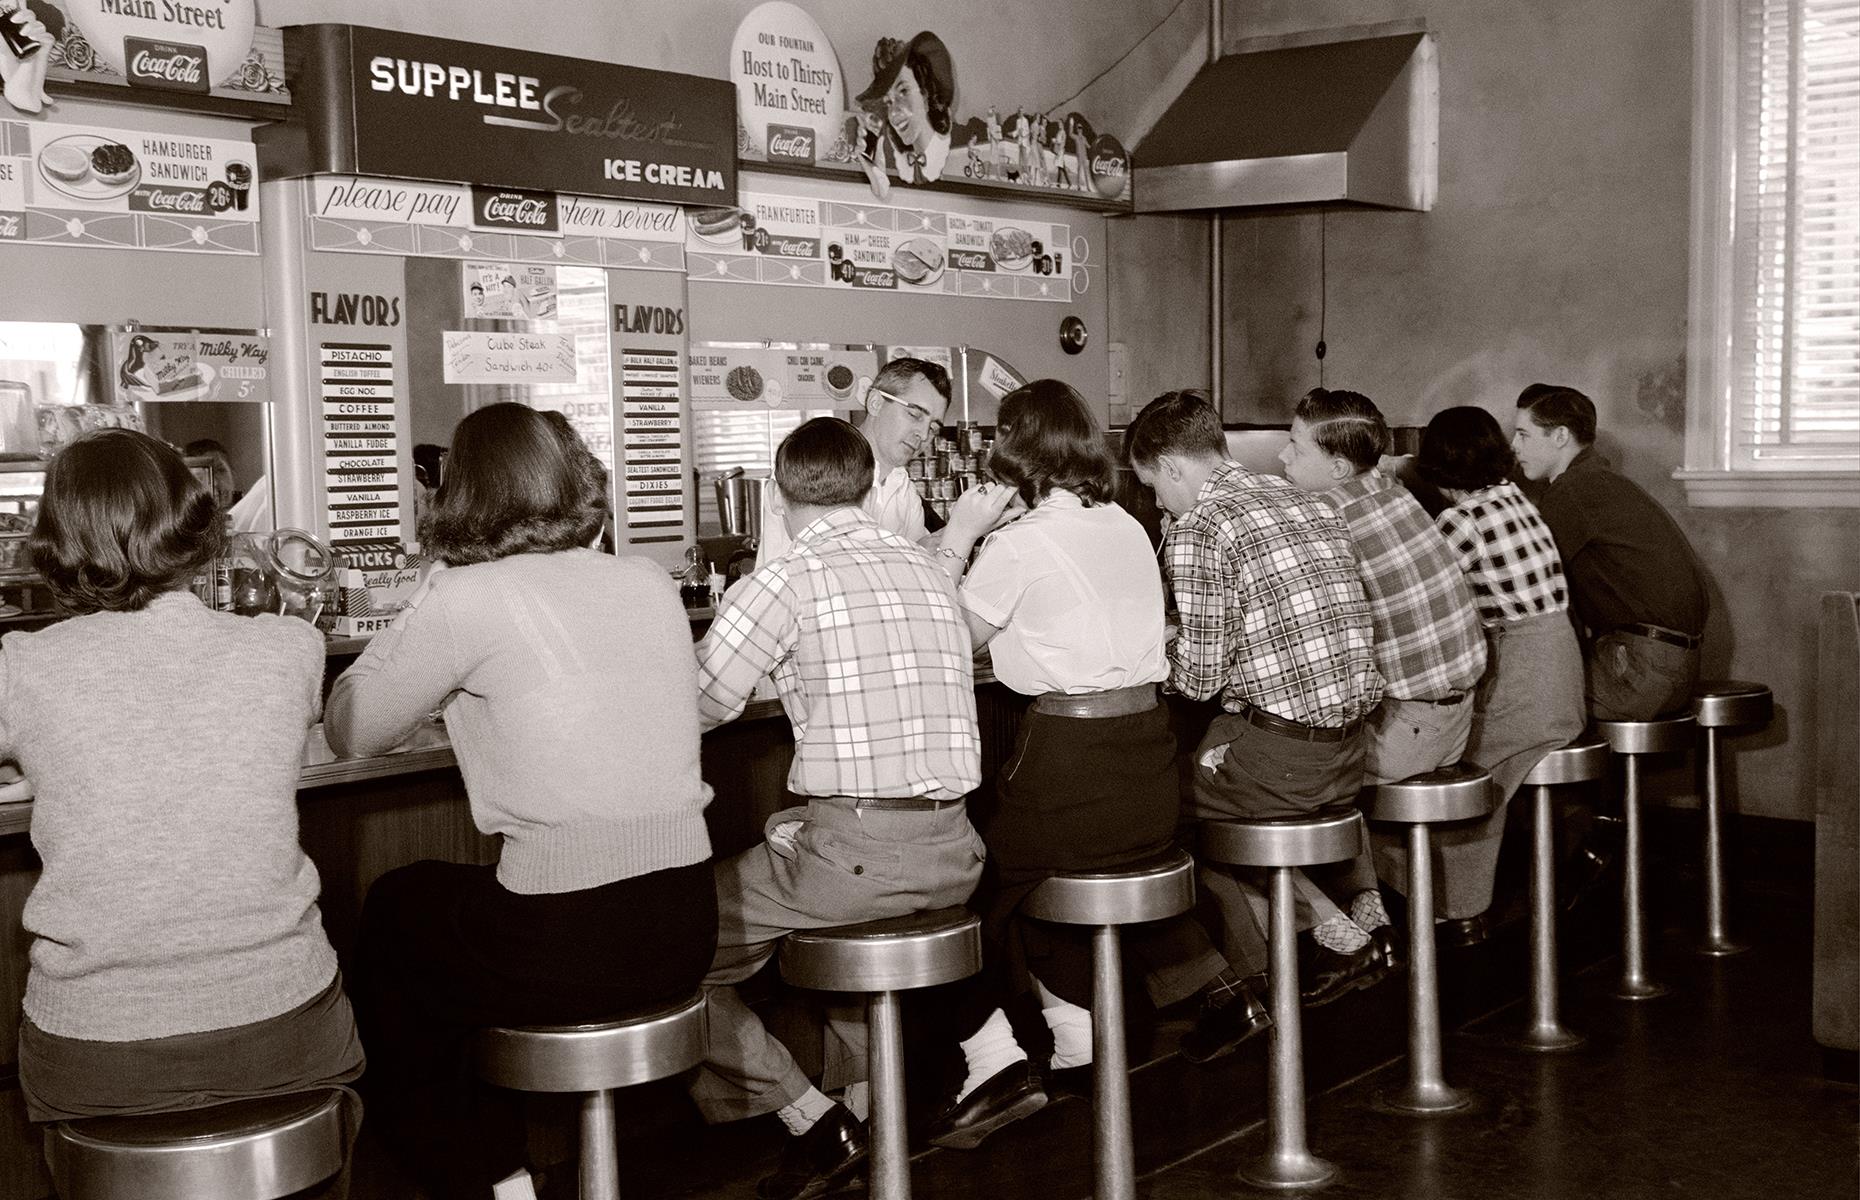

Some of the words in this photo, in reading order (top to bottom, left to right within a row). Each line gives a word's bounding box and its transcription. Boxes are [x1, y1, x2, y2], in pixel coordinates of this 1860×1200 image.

[163, 0, 226, 30] Street
[758, 32, 776, 46] OUR
[779, 36, 815, 53] FOUNTAIN
[132, 50, 201, 83] Coca-Cola
[742, 49, 773, 78] Host
[776, 62, 789, 80] to
[790, 58, 834, 94] Thirsty
[370, 56, 541, 110] SUPPLEE
[753, 82, 788, 110] Main
[791, 87, 827, 115] Street
[143, 140, 213, 160] HAMBURGER
[770, 134, 812, 158] Coca-Cola
[150, 162, 208, 181] SANDWICH
[604, 158, 642, 182] ICE
[644, 163, 725, 190] CREAM
[1092, 155, 1125, 177] Coca-Cola
[149, 189, 205, 212] Coca-Cola
[210, 187, 230, 206] 26¢
[322, 178, 408, 215] please
[407, 192, 461, 224] pay
[500, 192, 523, 200] DRINK
[484, 195, 548, 225] Coca-Cola
[756, 204, 817, 225] FRANKFURTER
[610, 206, 680, 232] served
[845, 233, 860, 246] HAM
[868, 234, 890, 249] CHEESE
[955, 233, 985, 246] SANDWICH
[780, 240, 814, 257] Coca-Cola
[854, 249, 886, 264] SANDWICH
[958, 253, 986, 269] Coca-Cola
[863, 271, 894, 287] Coca-Cola
[311, 292, 400, 327] FLAVORS
[614, 304, 684, 335] FLAVORS
[519, 337, 546, 350] Steak
[174, 341, 189, 351] TRY
[190, 342, 197, 351] A
[200, 340, 239, 363] Milky
[240, 343, 268, 365] Way
[331, 351, 383, 361] PISTACHIO
[485, 357, 533, 372] Sandwich
[689, 356, 707, 366] BAKED
[709, 356, 727, 366] BEANS
[220, 366, 266, 380] CHILLED
[333, 369, 358, 378] ENGLISH
[360, 369, 380, 378] TOFFEE
[693, 375, 721, 385] WIENERS
[340, 387, 355, 395] EGG
[358, 387, 375, 395] NOG
[339, 404, 379, 413] COFFEE
[333, 440, 363, 448] VANILLA
[366, 440, 388, 448] FUDGE
[339, 459, 384, 469] CHOCOLATE
[651, 465, 679, 473] SANDWICHES
[338, 473, 384, 483] STRAWBERRY
[640, 481, 669, 489] DIXIES
[347, 493, 381, 502] VANILLA
[336, 510, 377, 520] RASPBERRY
[379, 509, 391, 518] ICE
[343, 528, 373, 537] ORANGE
[376, 528, 387, 536] ICE
[393, 571, 417, 588] Good
[357, 619, 396, 632] PRET
